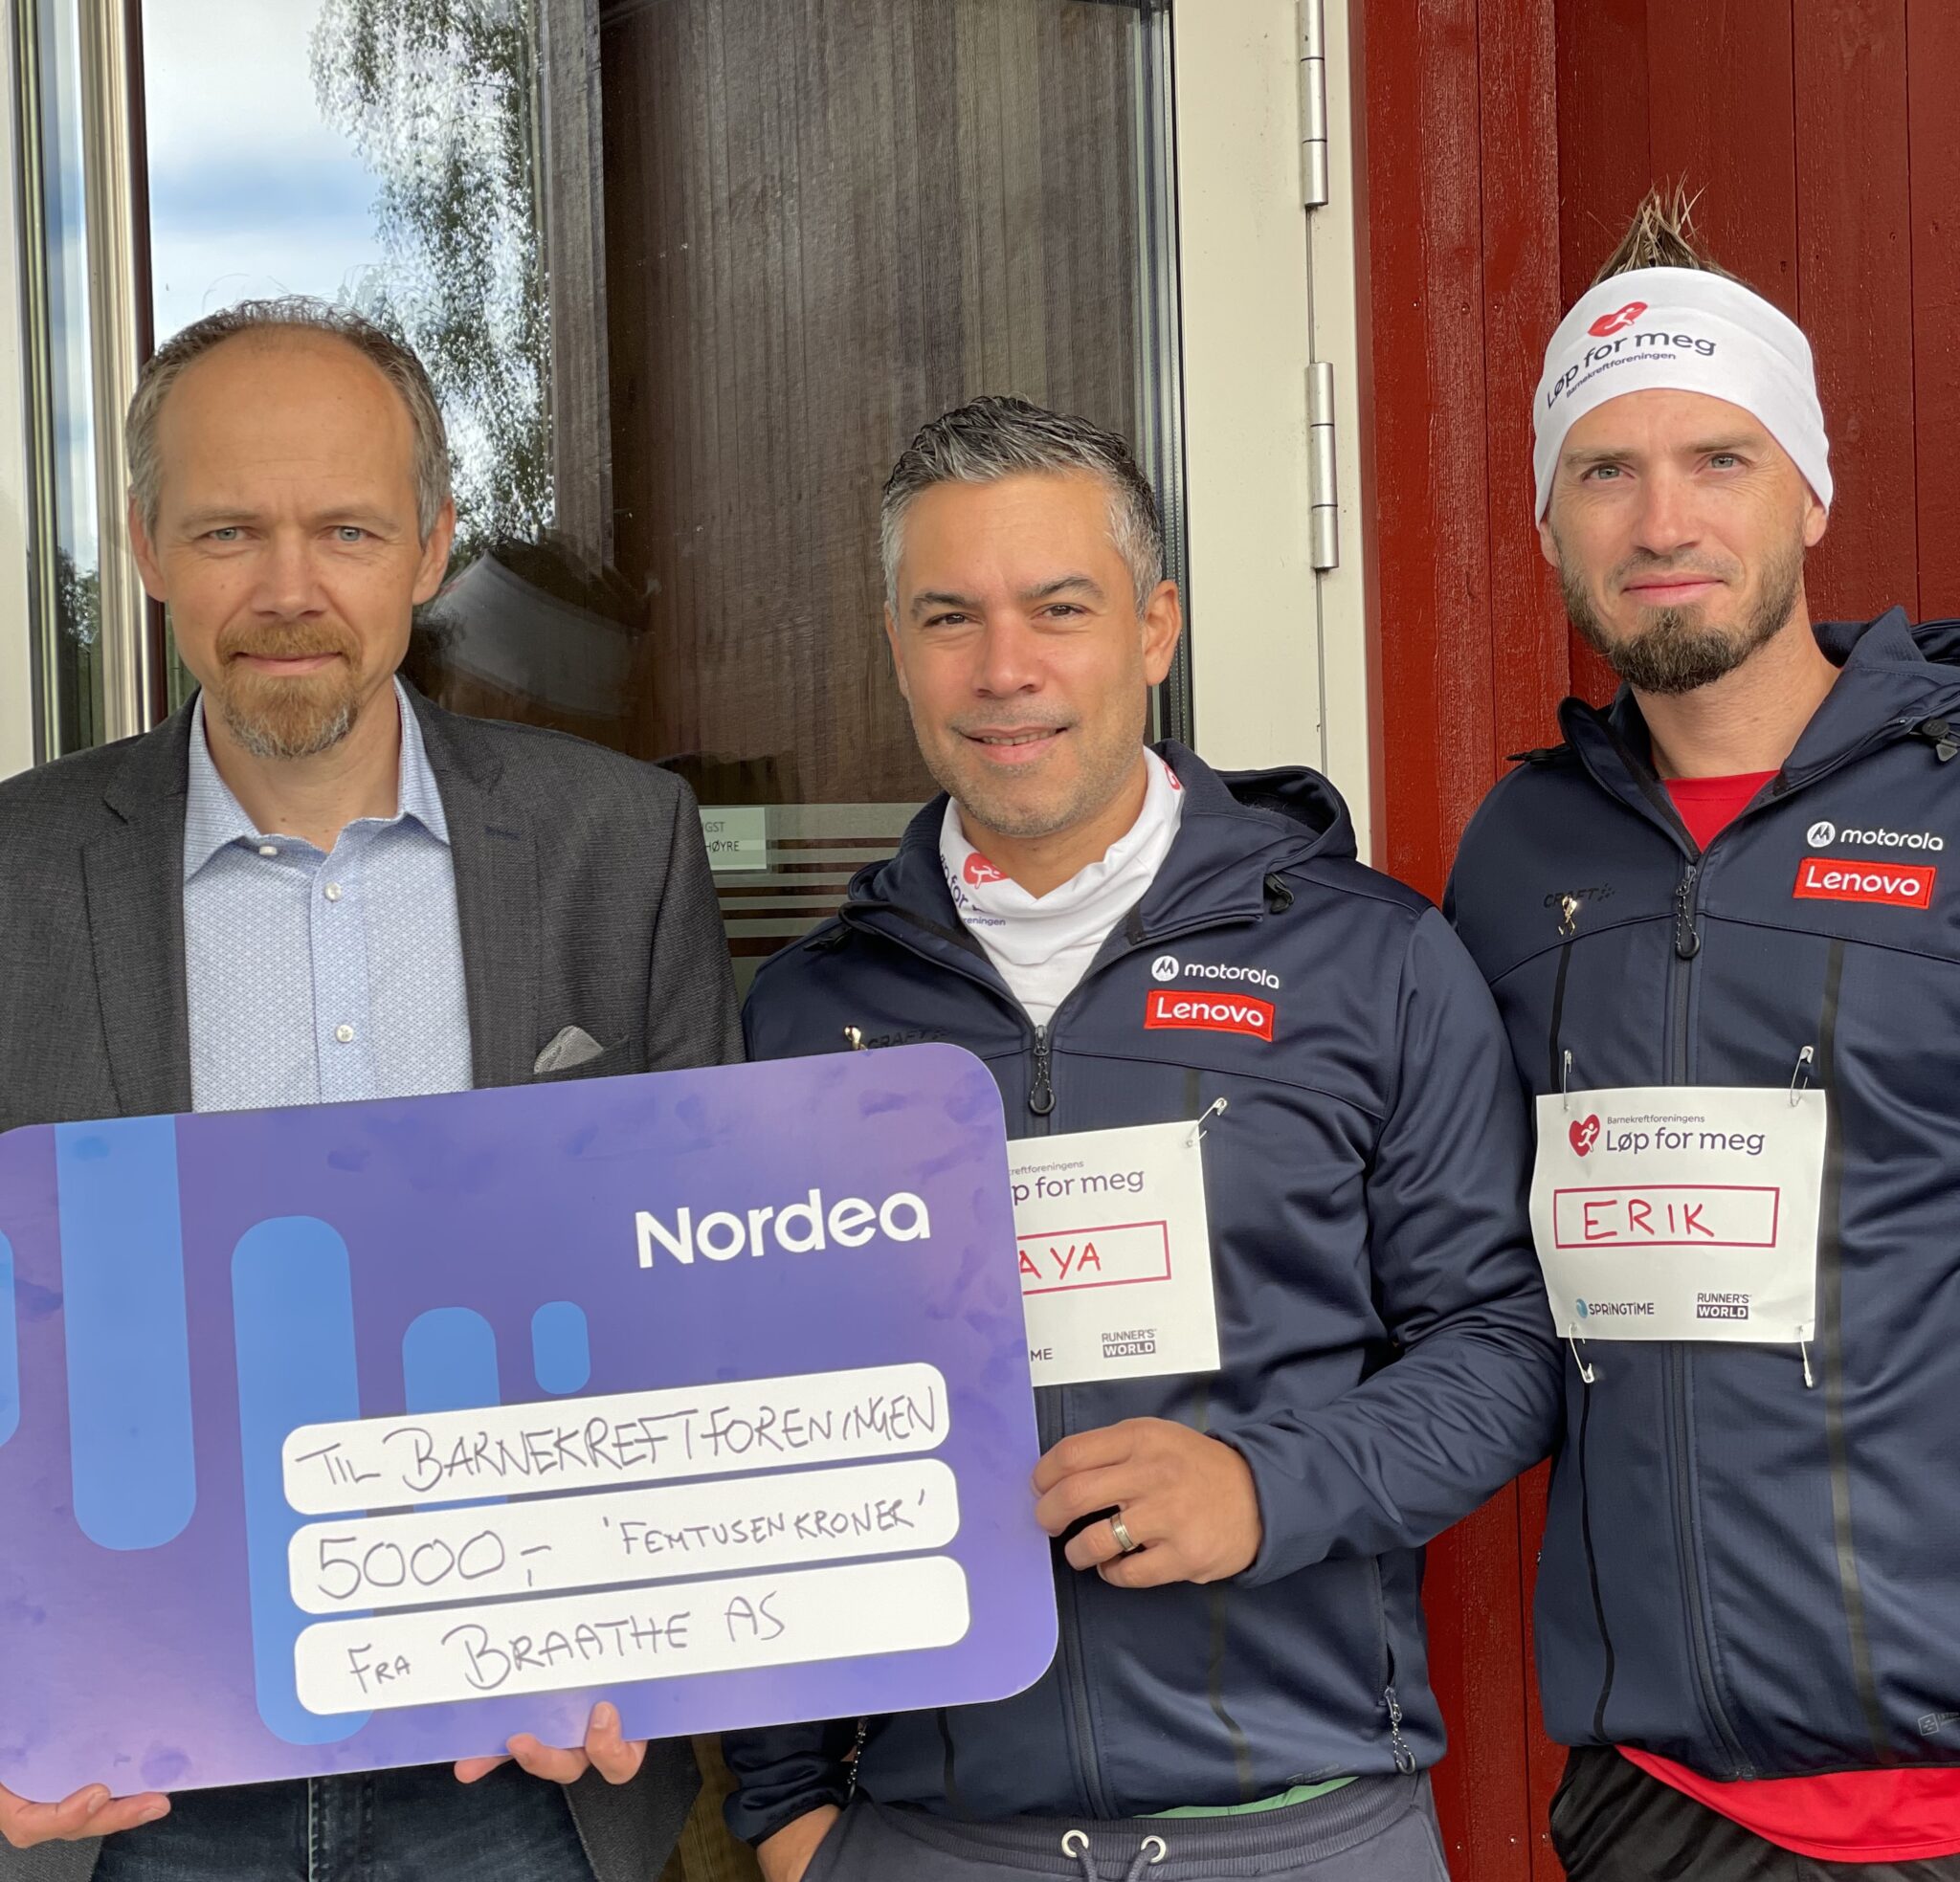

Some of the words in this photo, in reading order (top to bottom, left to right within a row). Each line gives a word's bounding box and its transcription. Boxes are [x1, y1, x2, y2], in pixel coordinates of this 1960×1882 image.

[1547, 365, 1579, 410] Løp
[1584, 337, 1628, 367] for
[1635, 331, 1717, 356] meg
[1566, 352, 1677, 398] Barnekreftforeningen
[702, 821, 725, 833] GST
[1840, 828, 1944, 851] motorola
[1805, 865, 1920, 897] Lenovo
[1185, 963, 1280, 989] motorola
[1156, 996, 1264, 1027] Lenovo
[1607, 1114, 1705, 1124] Barnekreftforeningens
[1606, 1130, 1650, 1155] Løp
[1655, 1126, 1694, 1149] for
[1699, 1132, 1766, 1156] meg
[1009, 1160, 1085, 1176] reftforeningens
[1035, 1176, 1075, 1199] for
[1080, 1170, 1145, 1193] meg
[635, 1187, 931, 1269] Nordea
[1583, 1198, 1715, 1241] ERIK
[1697, 1293, 1749, 1304] RUNNER'S
[1698, 1306, 1748, 1318] WORLD
[1102, 1328, 1155, 1343] RUNNER'S
[1103, 1341, 1154, 1357] WORLD
[295, 1442, 382, 1485] TIL
[440, 1611, 691, 1691] BRAATHE
[724, 1590, 786, 1643] AS
